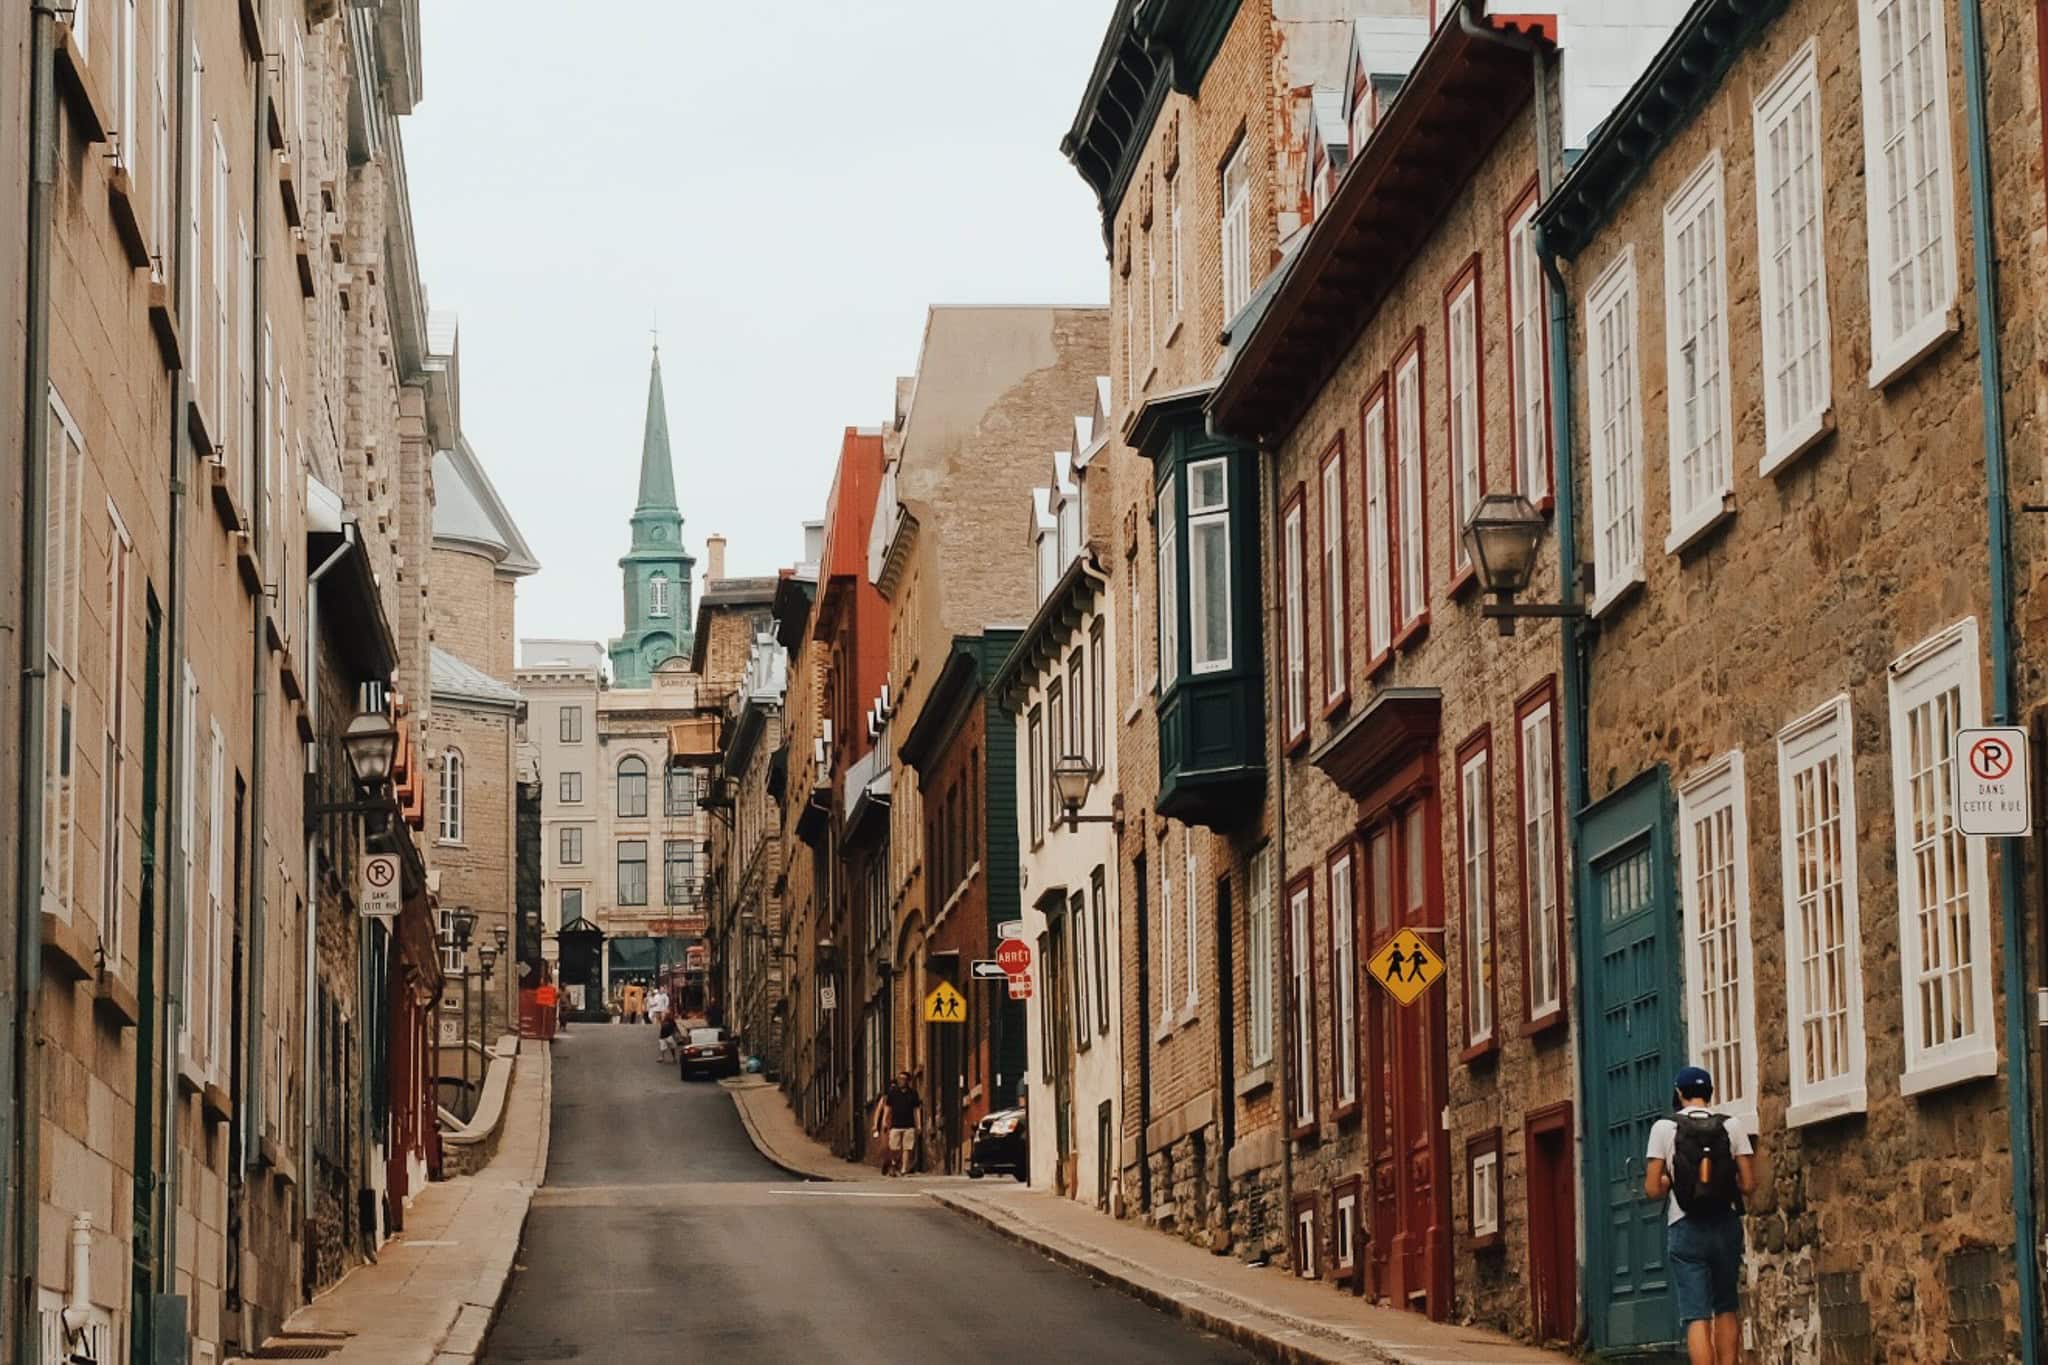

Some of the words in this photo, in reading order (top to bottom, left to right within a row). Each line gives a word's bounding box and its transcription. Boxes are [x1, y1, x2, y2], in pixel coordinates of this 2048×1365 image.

[1979, 784, 2005, 795] DANS
[1963, 801, 1993, 813] CETTE
[2000, 800, 2022, 812] RUE
[998, 949, 1029, 963] ARRÊT
